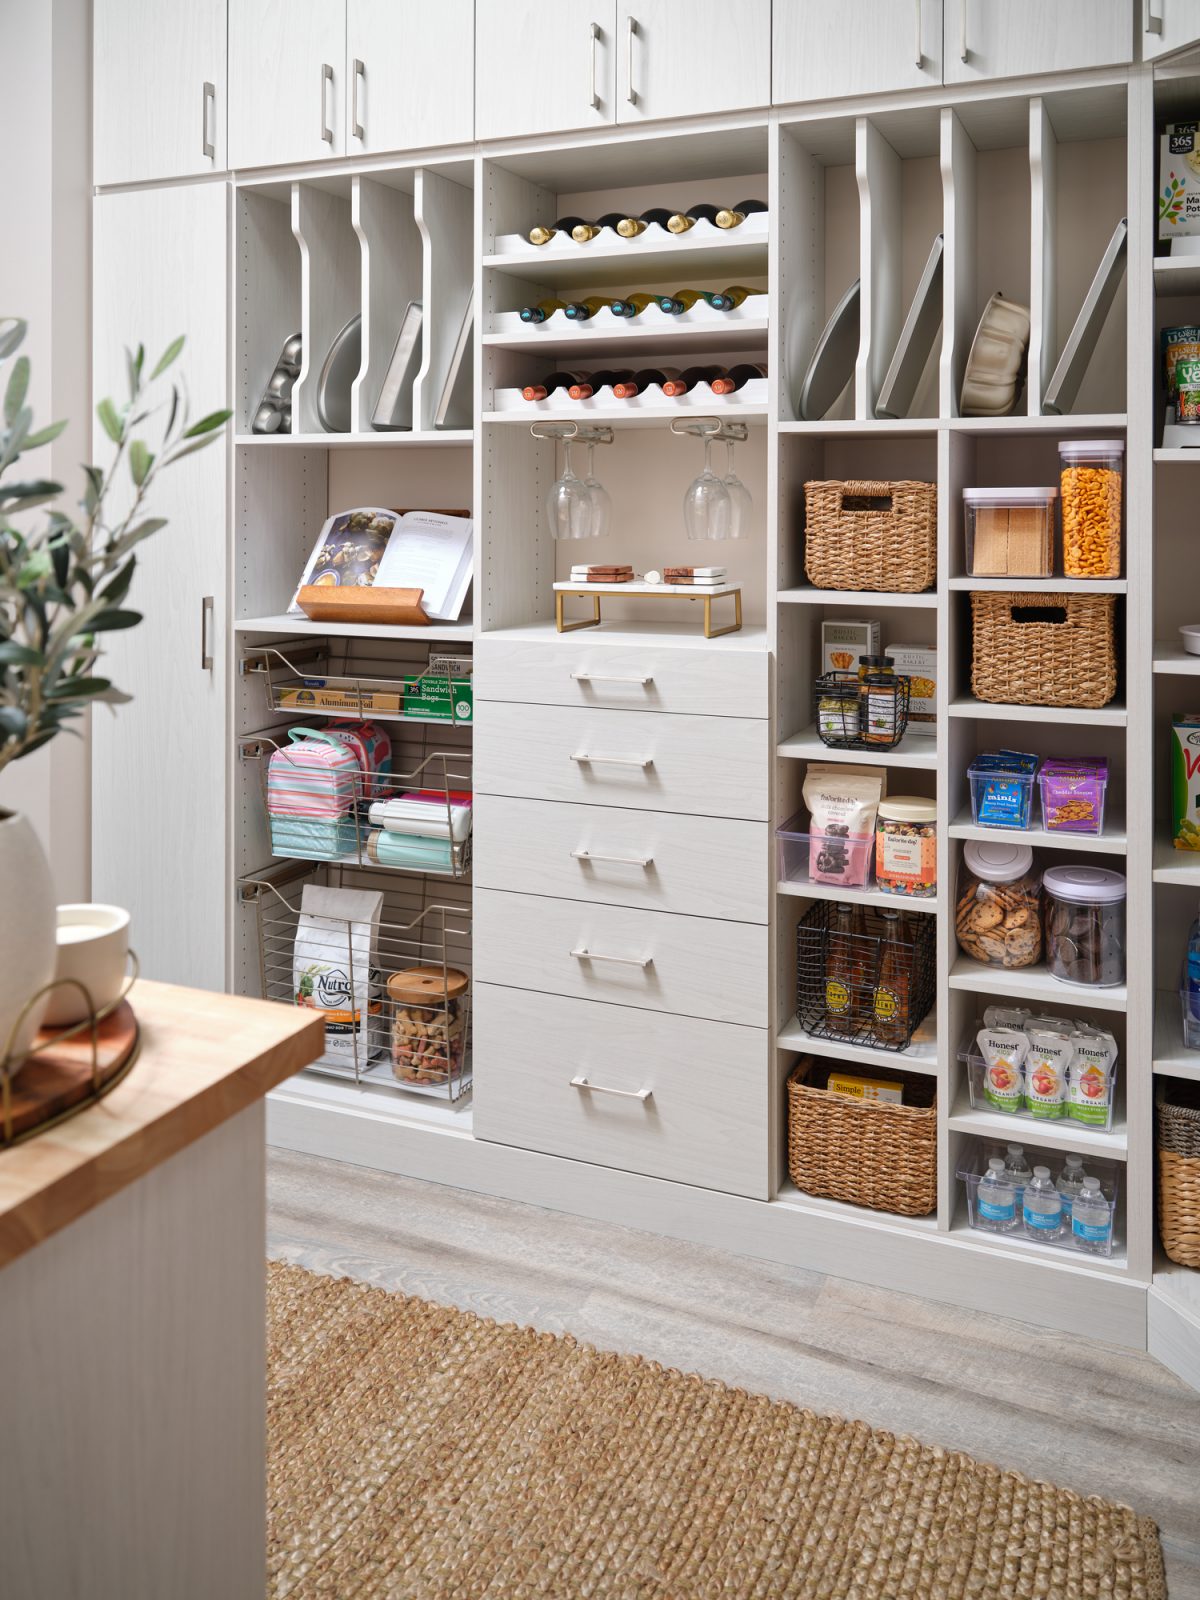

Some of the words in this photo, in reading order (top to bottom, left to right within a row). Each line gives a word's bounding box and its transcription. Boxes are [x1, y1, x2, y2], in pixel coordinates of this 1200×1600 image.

[1171, 136, 1192, 148] 365
[421, 684, 458, 695] Sandwich
[421, 693, 440, 702] Bags
[319, 698, 359, 709] Aluminum
[457, 704, 470, 712] 100
[987, 794, 1017, 803] minis
[317, 974, 352, 991] Nutro
[995, 1020, 1025, 1031] Honest
[988, 1039, 1020, 1051] Honest
[1031, 1044, 1063, 1057] Honest
[1078, 1047, 1109, 1058] Honest
[835, 1083, 862, 1095] Simple
[1032, 1095, 1058, 1103] ORGANIC
